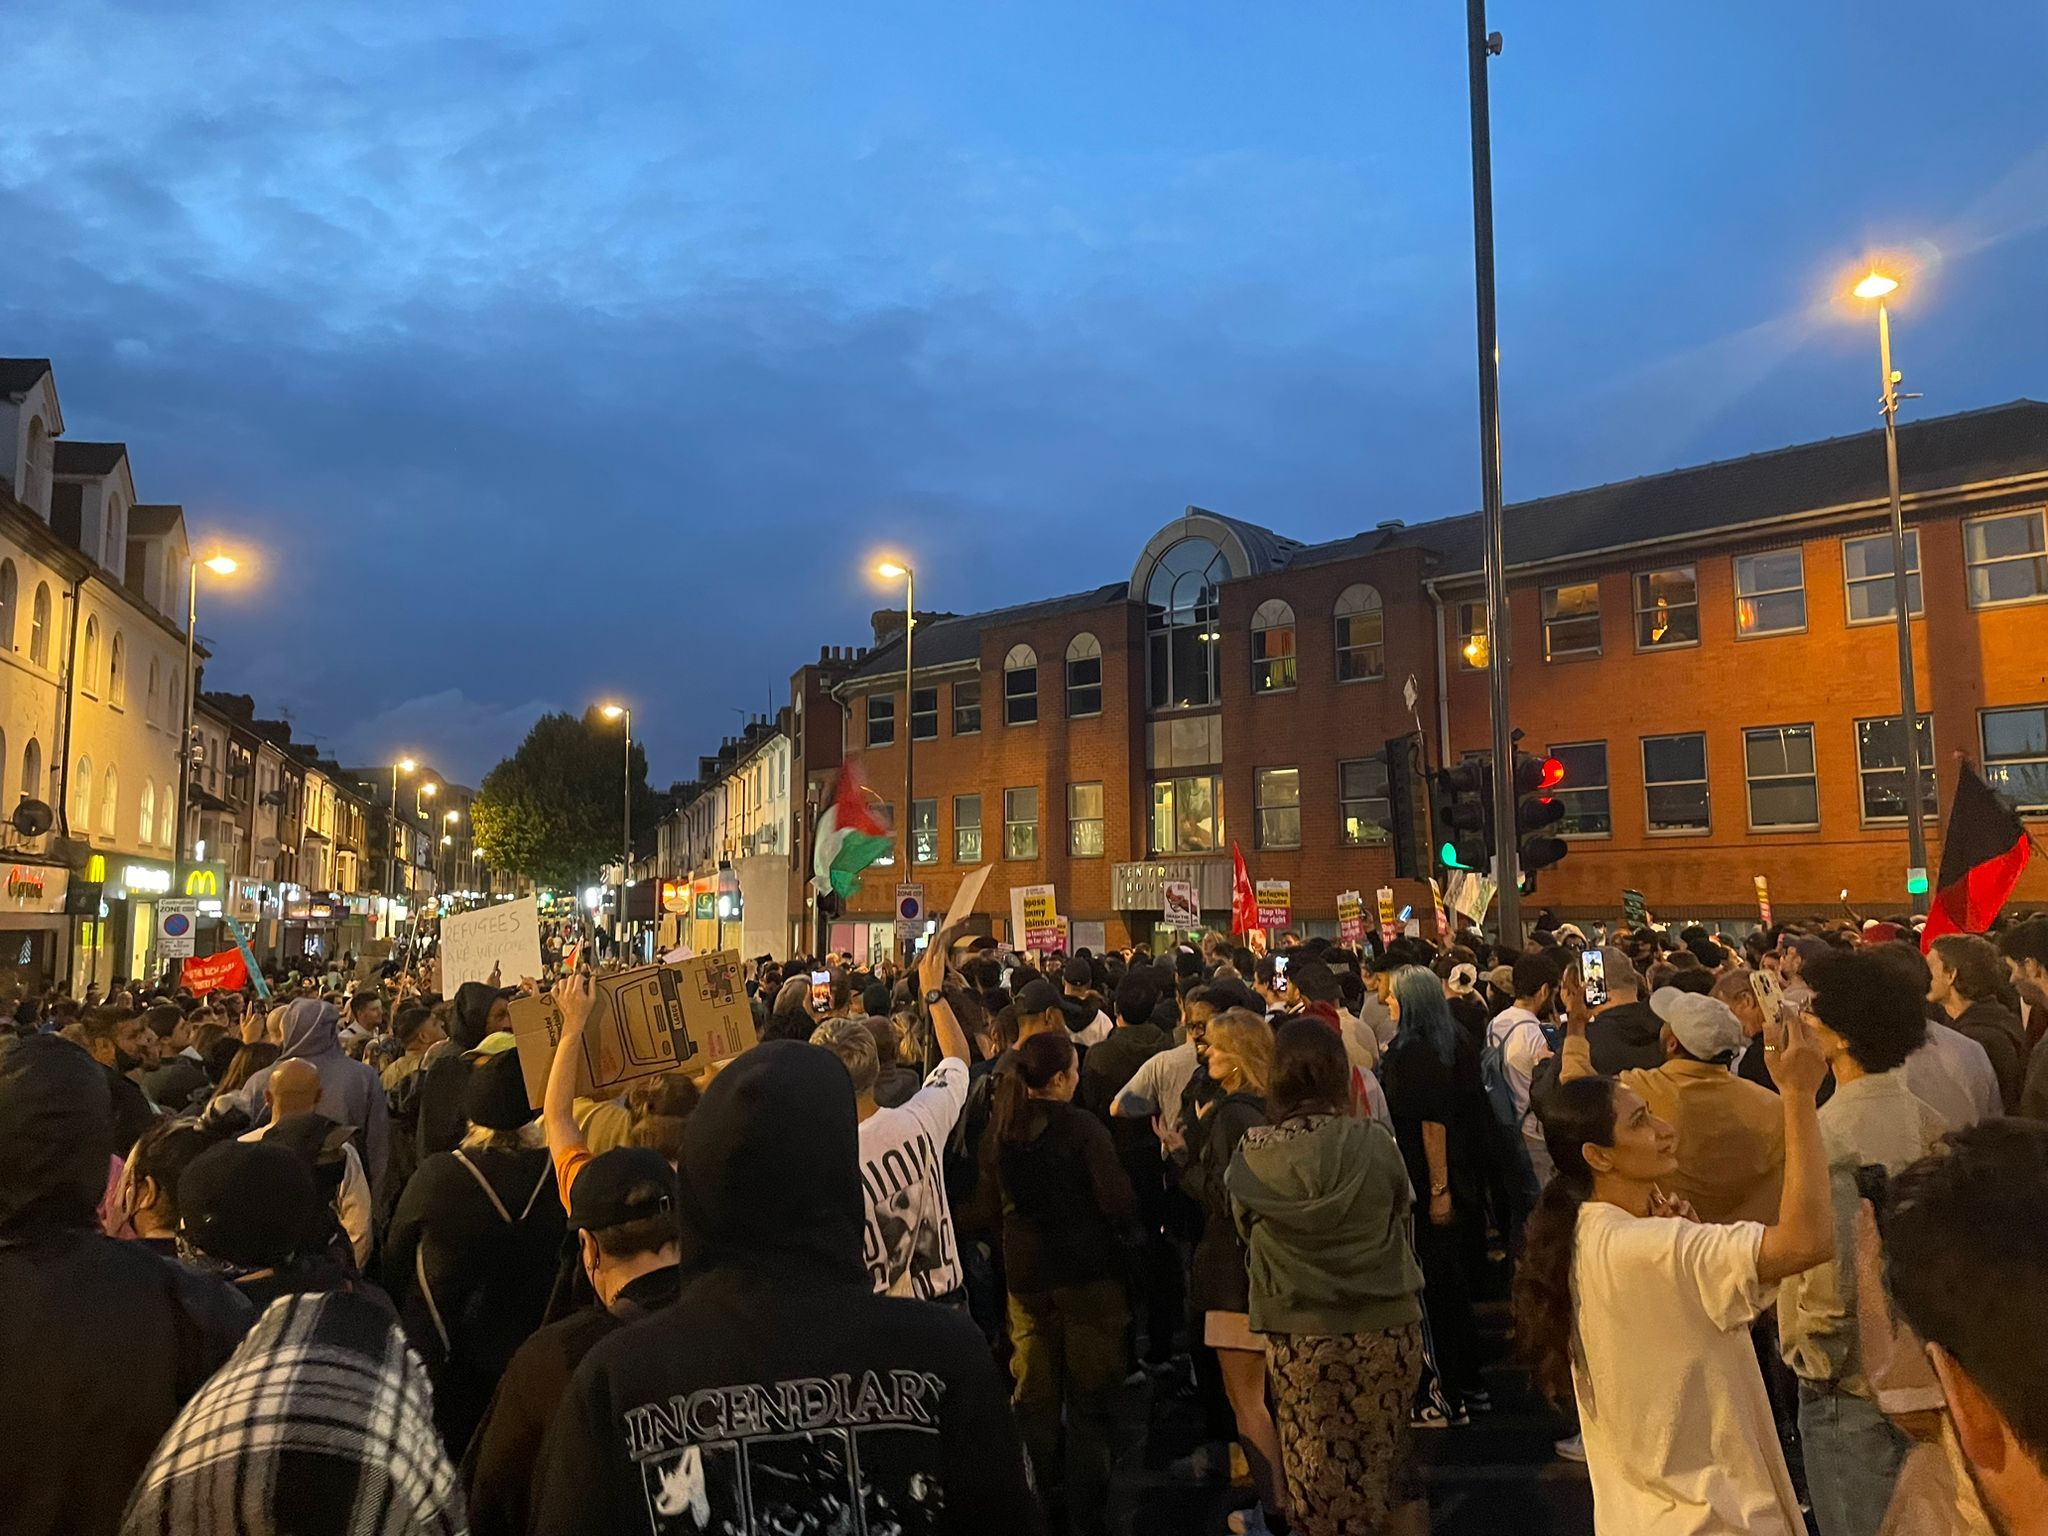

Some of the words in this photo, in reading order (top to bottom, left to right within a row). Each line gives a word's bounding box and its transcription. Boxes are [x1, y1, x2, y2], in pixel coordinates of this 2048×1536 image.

[1258, 908, 1274, 916] Stop
[445, 911, 520, 943] REFUGEES
[1258, 915, 1270, 923] far
[1270, 916, 1286, 925] right
[670, 1004, 680, 1025] LARGE
